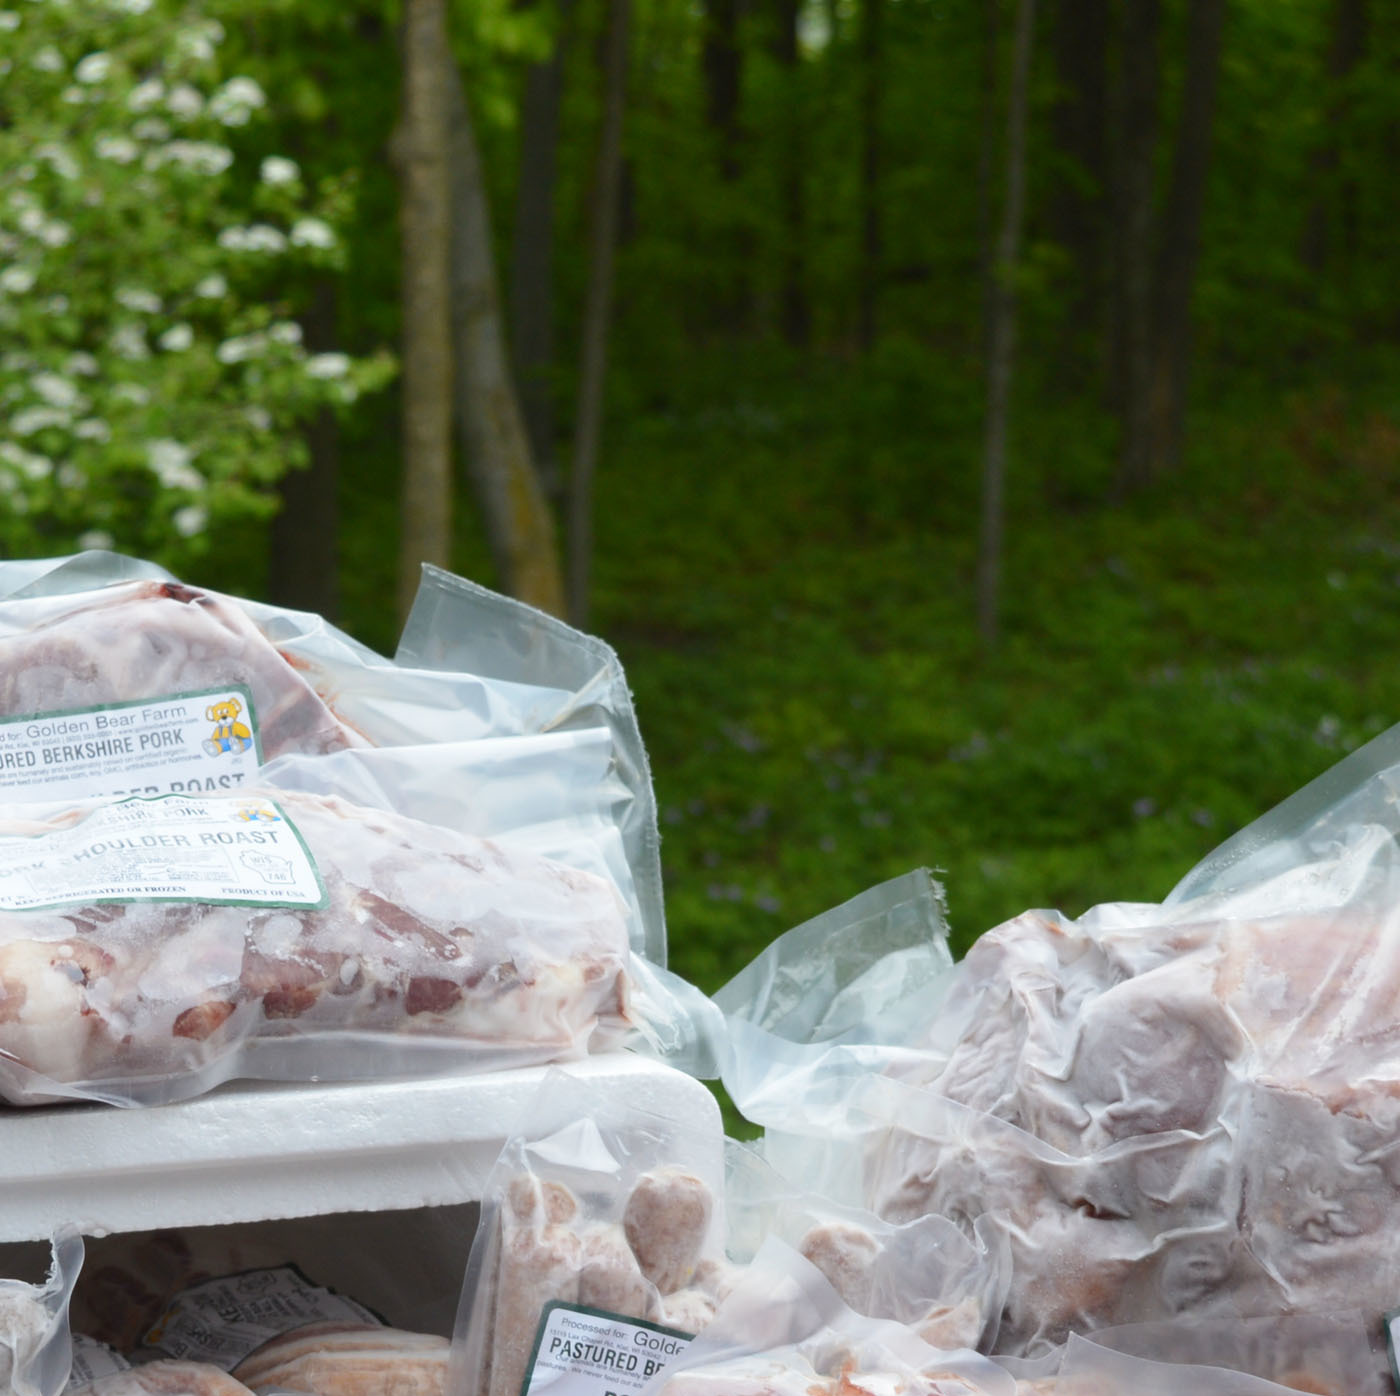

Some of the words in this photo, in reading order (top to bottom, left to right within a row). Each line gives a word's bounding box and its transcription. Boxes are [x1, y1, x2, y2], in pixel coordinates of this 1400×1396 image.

[26, 720, 90, 740] Golden
[96, 714, 136, 730] Bear
[143, 705, 187, 722] Farm
[42, 737, 134, 766] BERKSHIRE
[140, 729, 185, 750] PORK
[60, 830, 192, 868] HOULDER
[200, 829, 280, 846] ROAST
[549, 1336, 639, 1372] PASTURED
